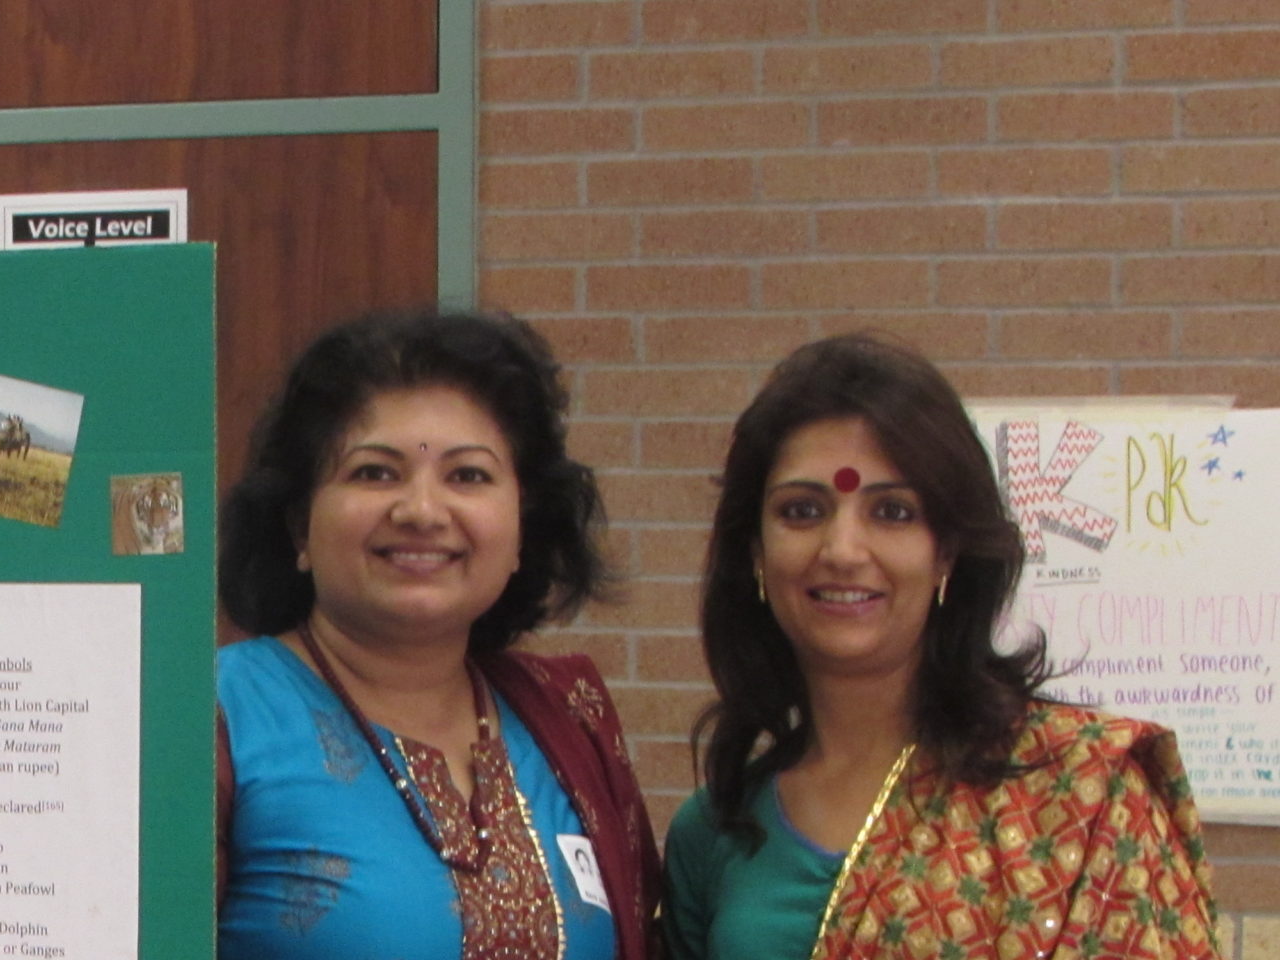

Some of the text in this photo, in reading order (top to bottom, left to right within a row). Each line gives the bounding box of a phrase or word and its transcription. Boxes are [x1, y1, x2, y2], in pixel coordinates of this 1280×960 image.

[28, 216, 153, 238] Voice Level
[1036, 566, 1101, 579] KINDNESS
[1180, 653, 1270, 676] someone,
[1114, 684, 1240, 705] awkwardness
[1255, 684, 1275, 703] of
[14, 700, 42, 712] Lion
[46, 700, 89, 714] Capital
[28, 720, 62, 733] Mana
[3, 740, 61, 753] Mataram
[17, 761, 59, 775] rupee)
[5, 882, 55, 895] Peafowl
[0, 921, 48, 937] Dolphin
[3, 945, 18, 954] or
[21, 942, 65, 957] Ganges
